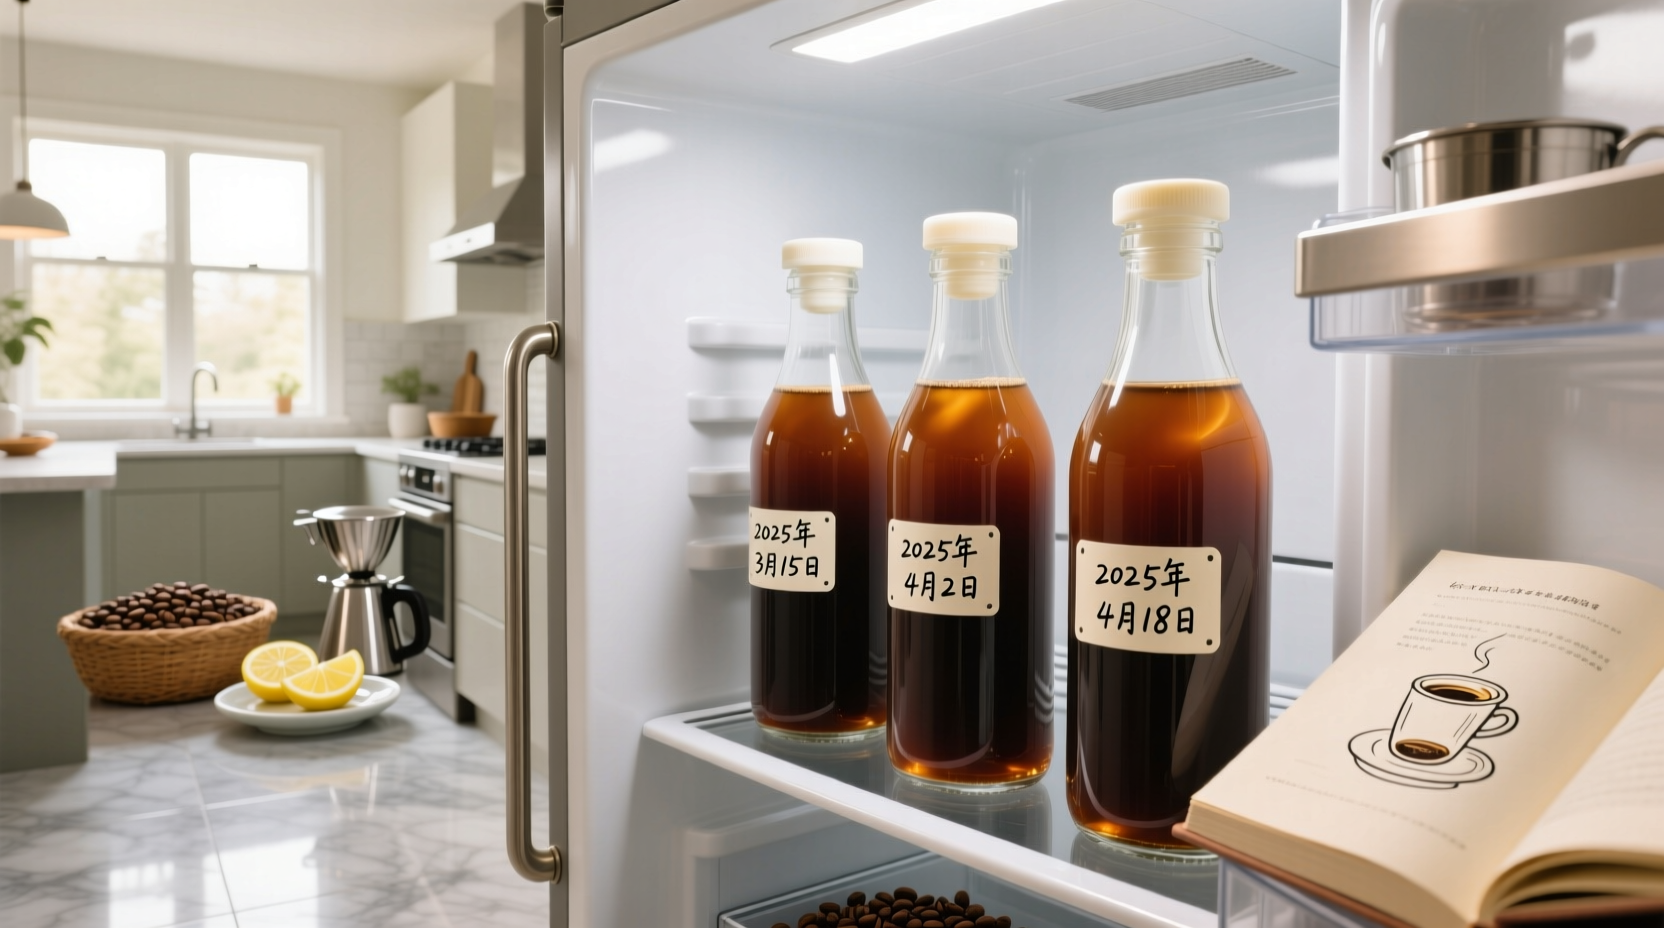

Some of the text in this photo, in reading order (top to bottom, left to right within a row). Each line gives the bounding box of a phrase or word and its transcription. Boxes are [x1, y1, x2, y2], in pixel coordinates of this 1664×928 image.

[754, 518, 816, 549] 2025年
[755, 551, 819, 578] 3月15日
[901, 533, 978, 569] 2025年
[904, 571, 977, 600] 4月2日
[1094, 557, 1191, 598] 2025年
[1096, 600, 1194, 636] 4月18日
